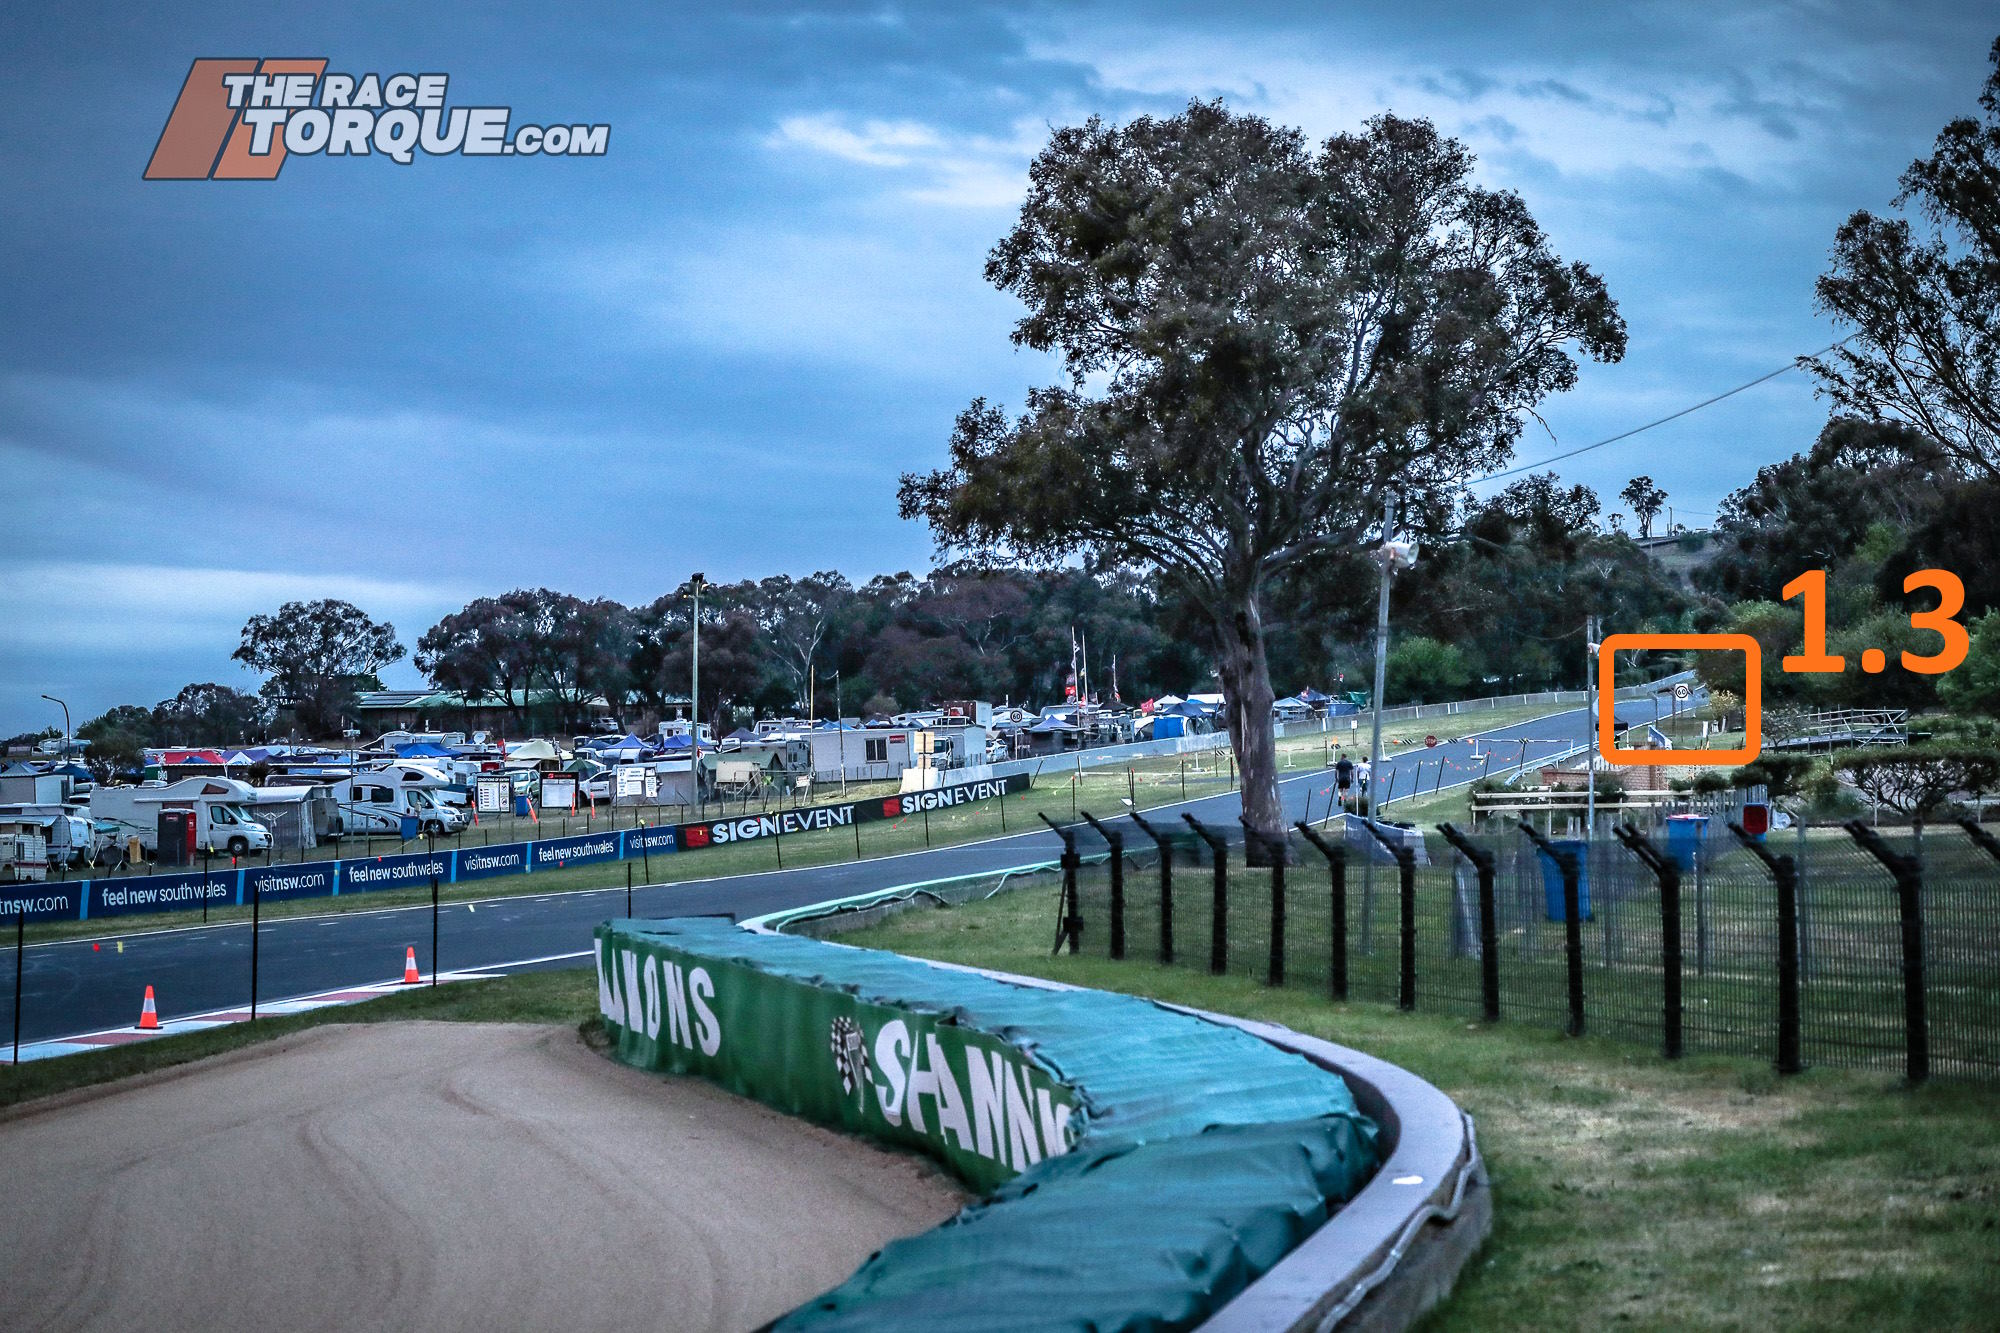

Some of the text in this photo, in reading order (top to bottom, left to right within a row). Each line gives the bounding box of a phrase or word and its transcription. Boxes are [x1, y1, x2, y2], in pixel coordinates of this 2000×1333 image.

[464, 853, 519, 871] visitnsw.com
[539, 841, 614, 862] feel new south wales
[349, 859, 444, 883] feel new south wales
[102, 880, 227, 906] feel new south wales
